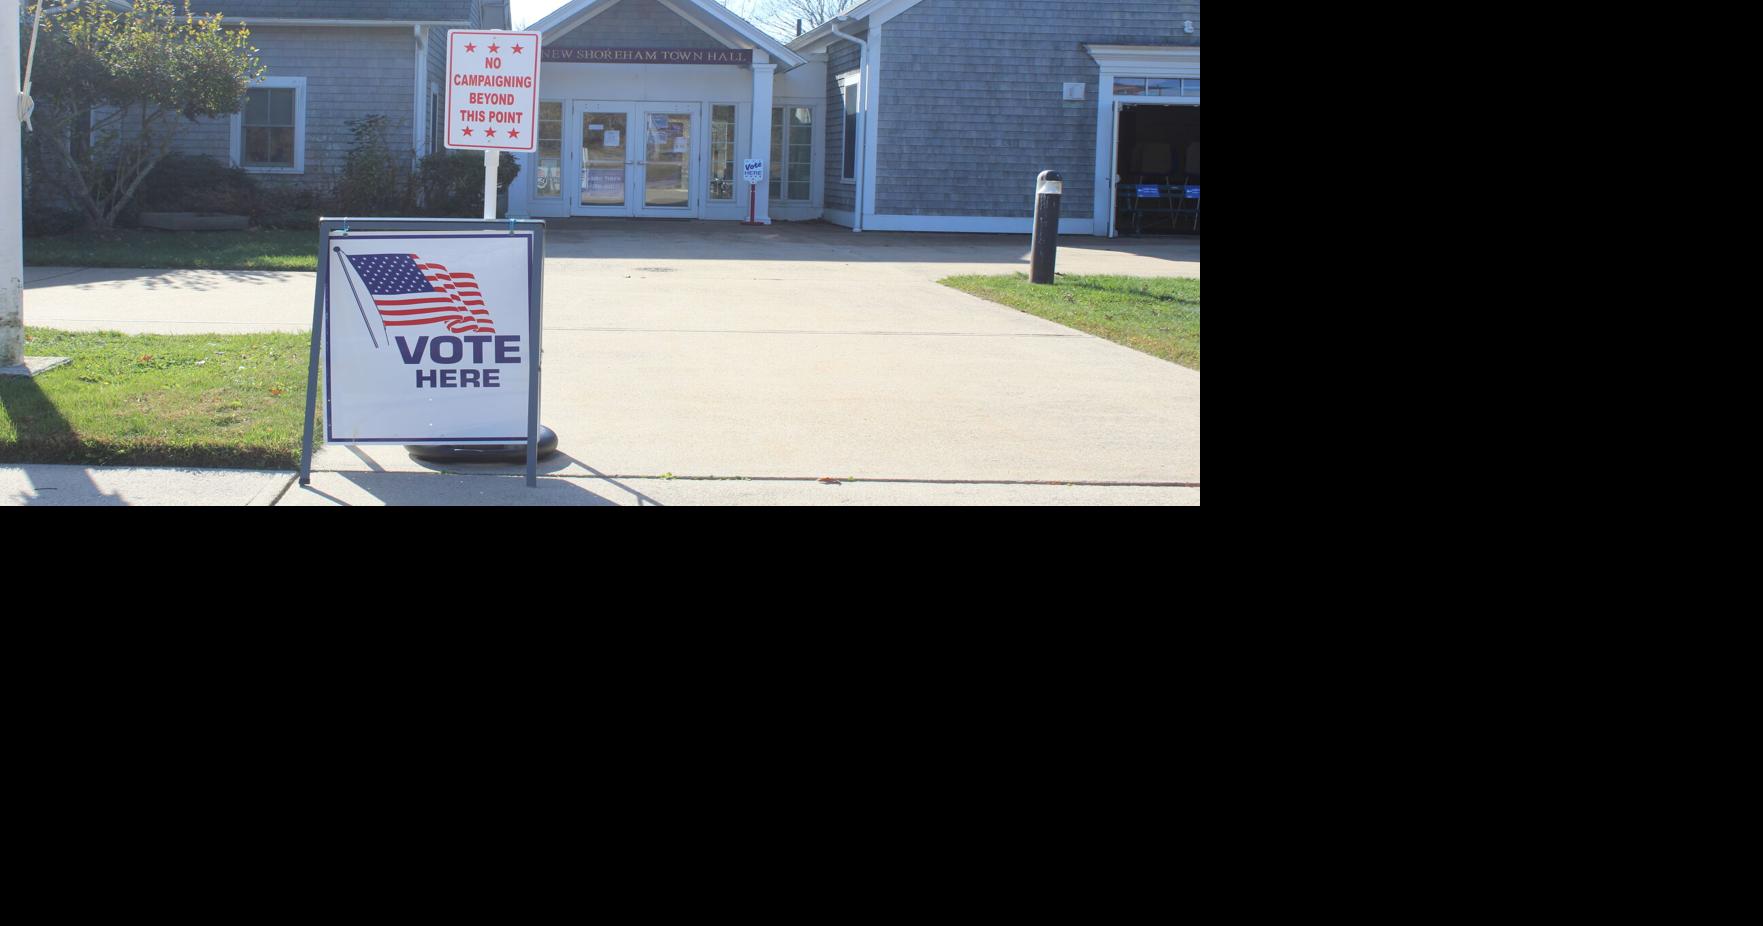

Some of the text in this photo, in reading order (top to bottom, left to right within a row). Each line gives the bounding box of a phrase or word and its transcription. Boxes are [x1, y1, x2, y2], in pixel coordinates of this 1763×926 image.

[541, 49, 747, 61] NEW SHOREHAM TOWN HALL
[485, 57, 501, 69] NO
[454, 74, 532, 88] CAMPAIGNING
[469, 92, 514, 105] BEYOND
[460, 110, 523, 123] THIS POINT
[395, 335, 521, 365] VOTE
[416, 369, 501, 388] HERE
